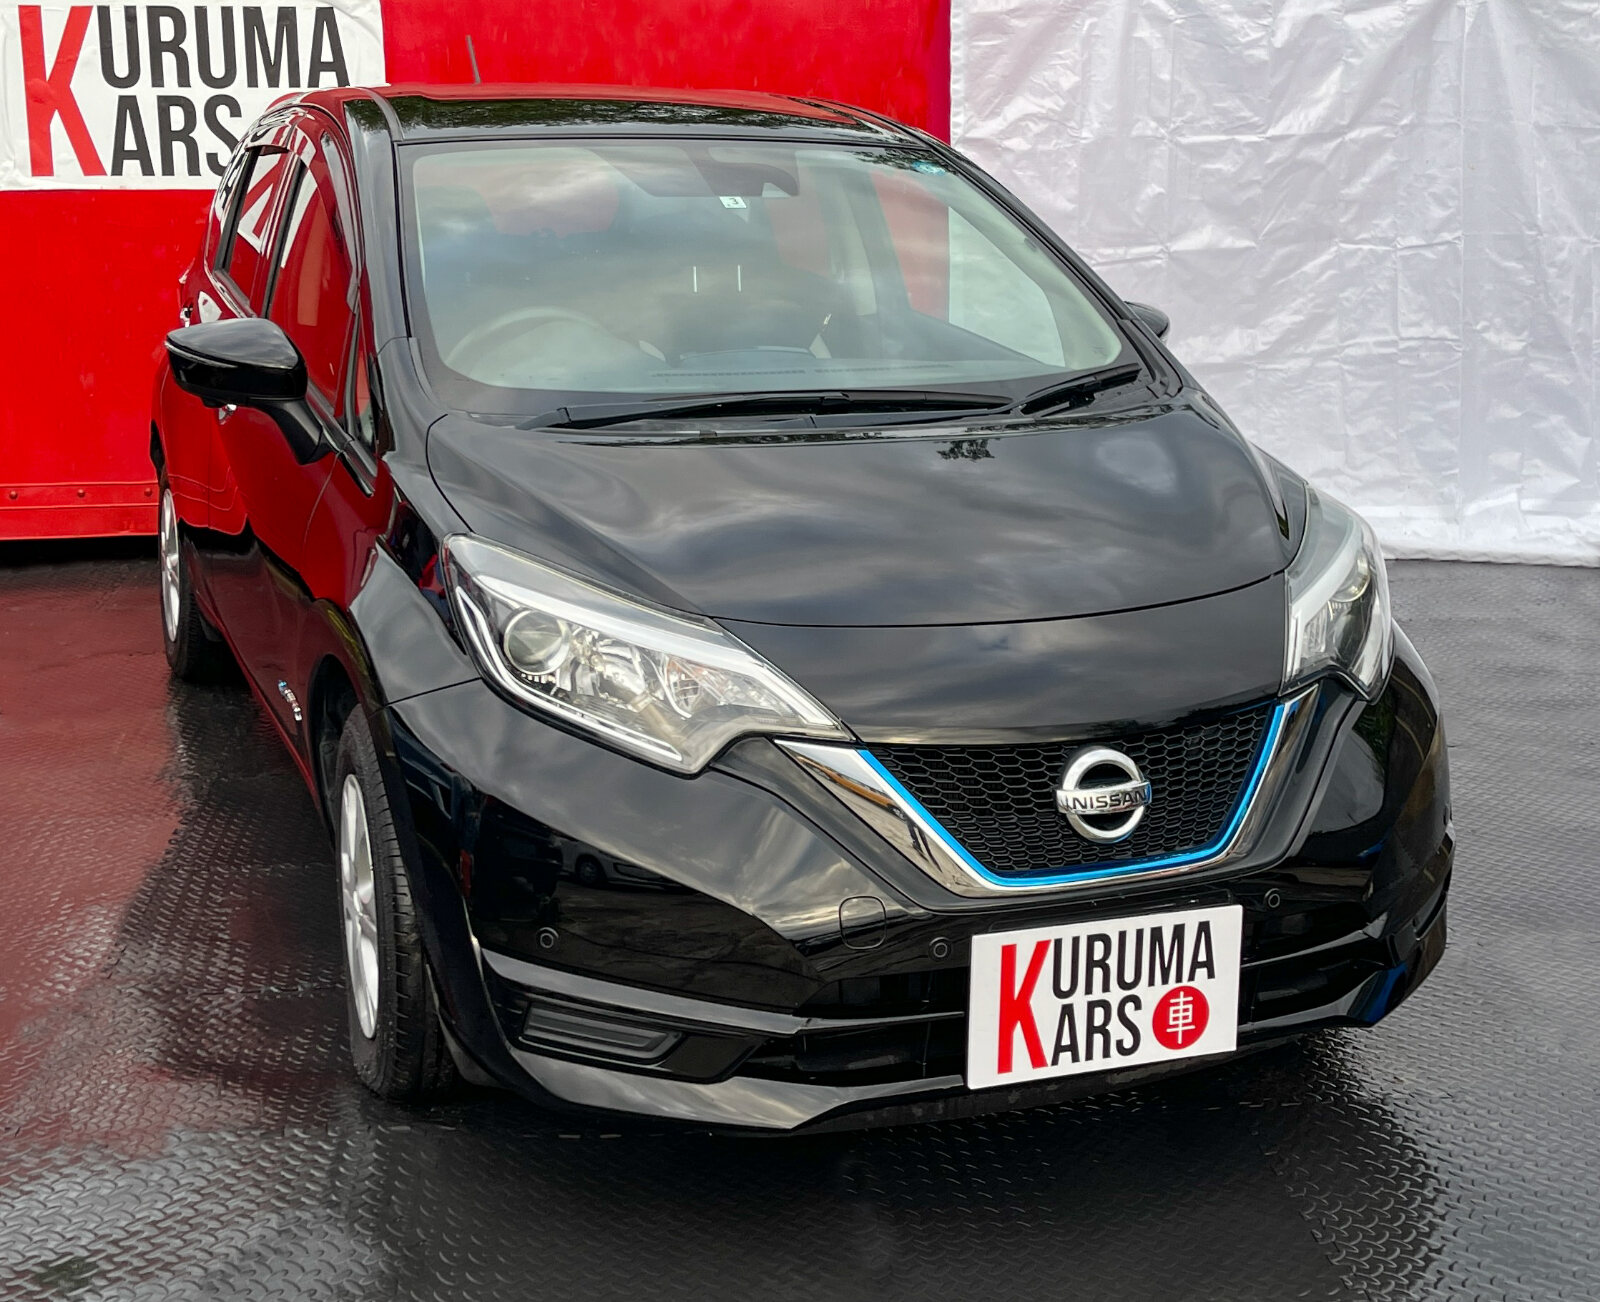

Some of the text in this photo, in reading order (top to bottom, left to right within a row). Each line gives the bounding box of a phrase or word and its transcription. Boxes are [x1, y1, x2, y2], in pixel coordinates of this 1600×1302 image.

[18, 5, 350, 177] KURUMA
[1071, 788, 1147, 810] NISSAN
[997, 920, 1216, 1074] KURUMA
[1166, 990, 1196, 1045] 車
